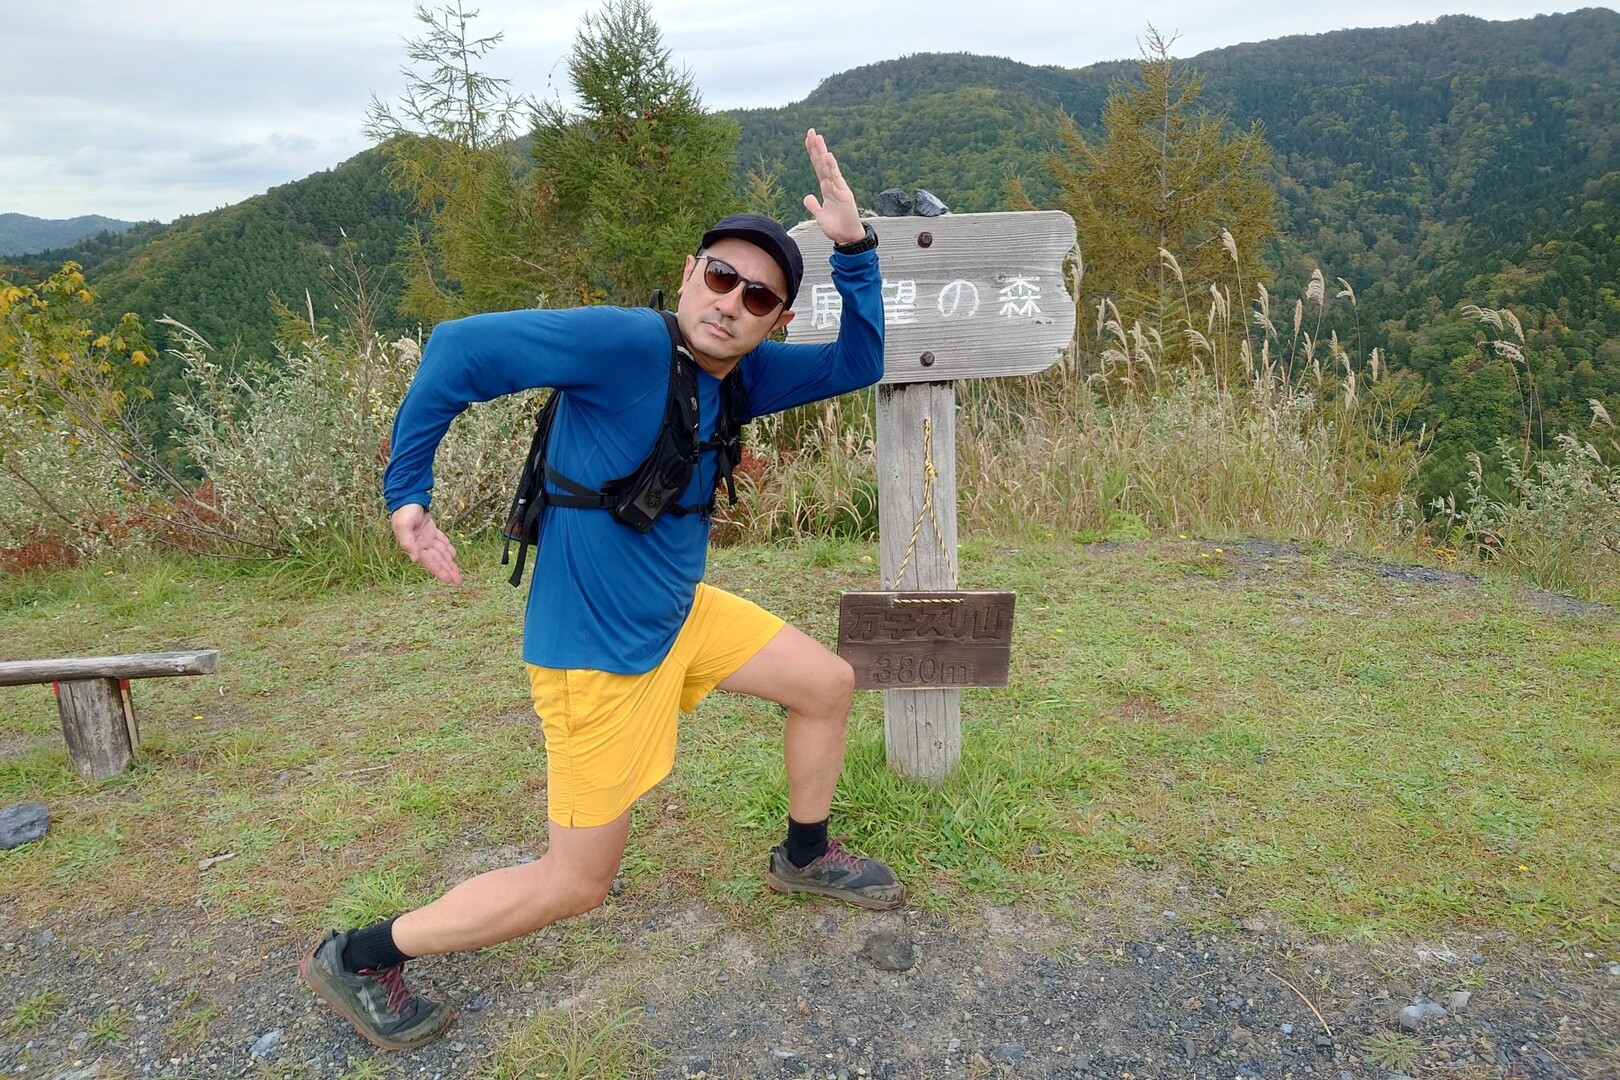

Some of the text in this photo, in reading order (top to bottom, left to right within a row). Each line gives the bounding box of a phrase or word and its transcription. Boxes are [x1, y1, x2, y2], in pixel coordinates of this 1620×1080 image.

[848, 604, 1006, 640] 万字ズリ山
[875, 654, 968, 684] 380m
